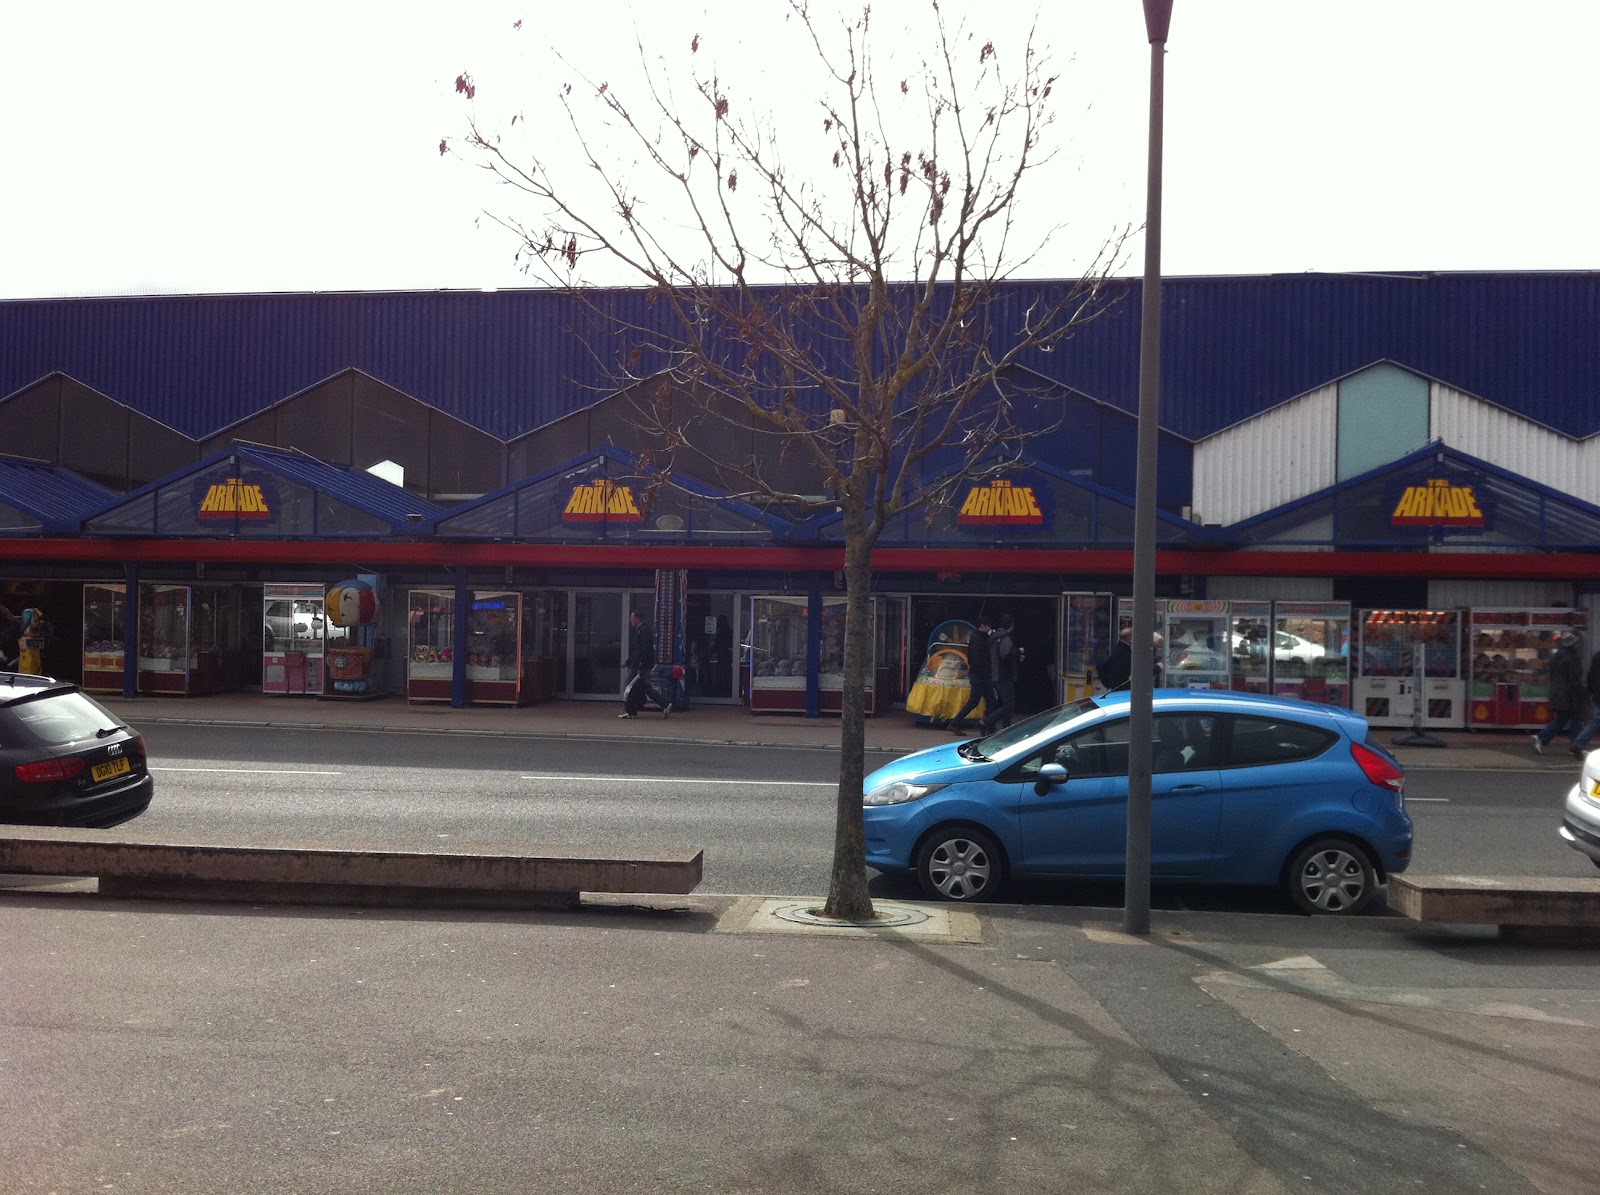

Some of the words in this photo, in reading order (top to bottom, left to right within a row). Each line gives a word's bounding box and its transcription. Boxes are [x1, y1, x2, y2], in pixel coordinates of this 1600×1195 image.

[200, 485, 269, 512] ARKADE
[564, 486, 640, 514] ARKADE
[960, 487, 1042, 516] ARKADE
[1393, 486, 1483, 517] ARKADE
